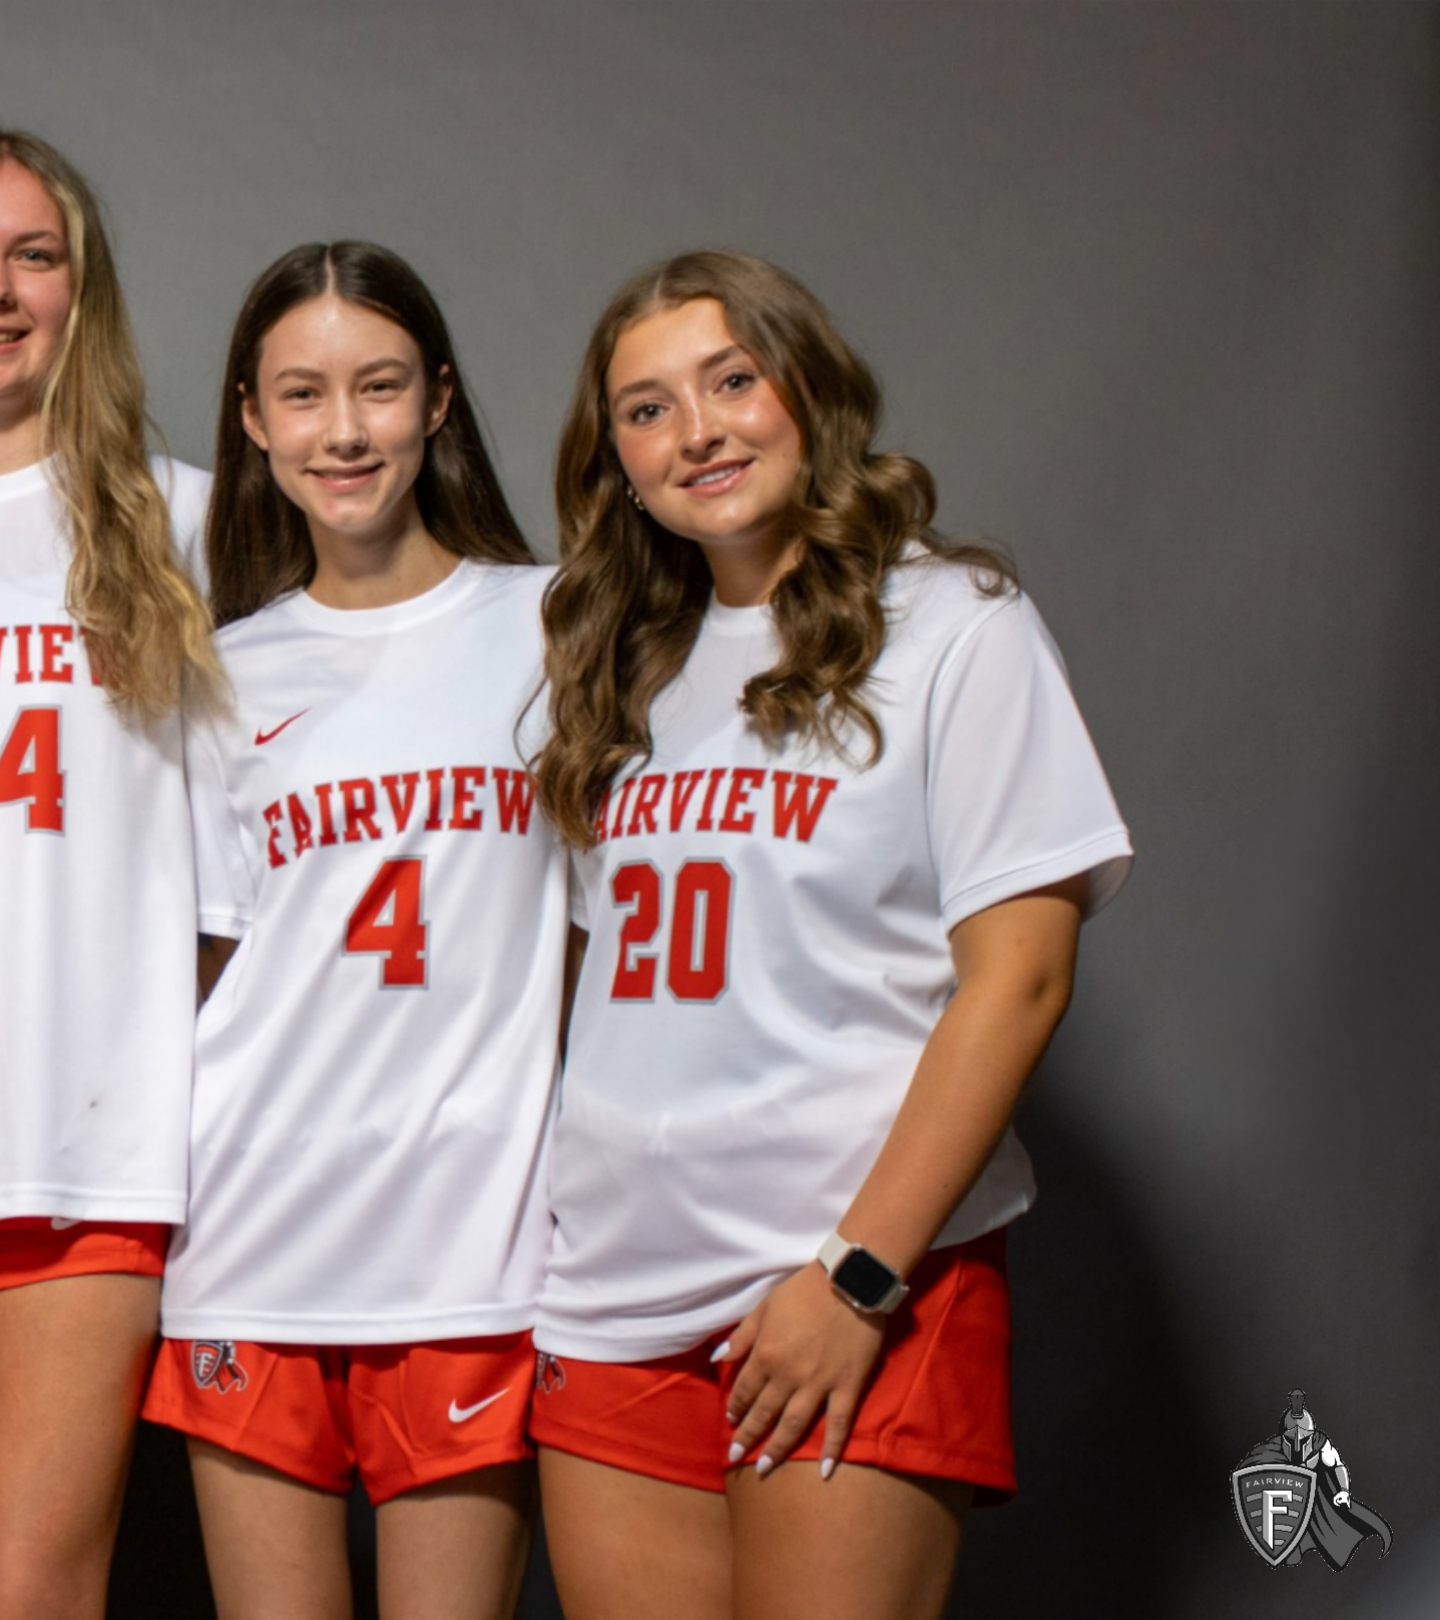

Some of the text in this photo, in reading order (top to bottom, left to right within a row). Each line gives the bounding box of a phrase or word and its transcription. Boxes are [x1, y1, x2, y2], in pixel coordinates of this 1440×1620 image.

[262, 766, 539, 869] FAIRVIEW
[591, 767, 839, 843] AIRVIEW
[341, 854, 431, 991] 4
[608, 856, 737, 1006] 20
